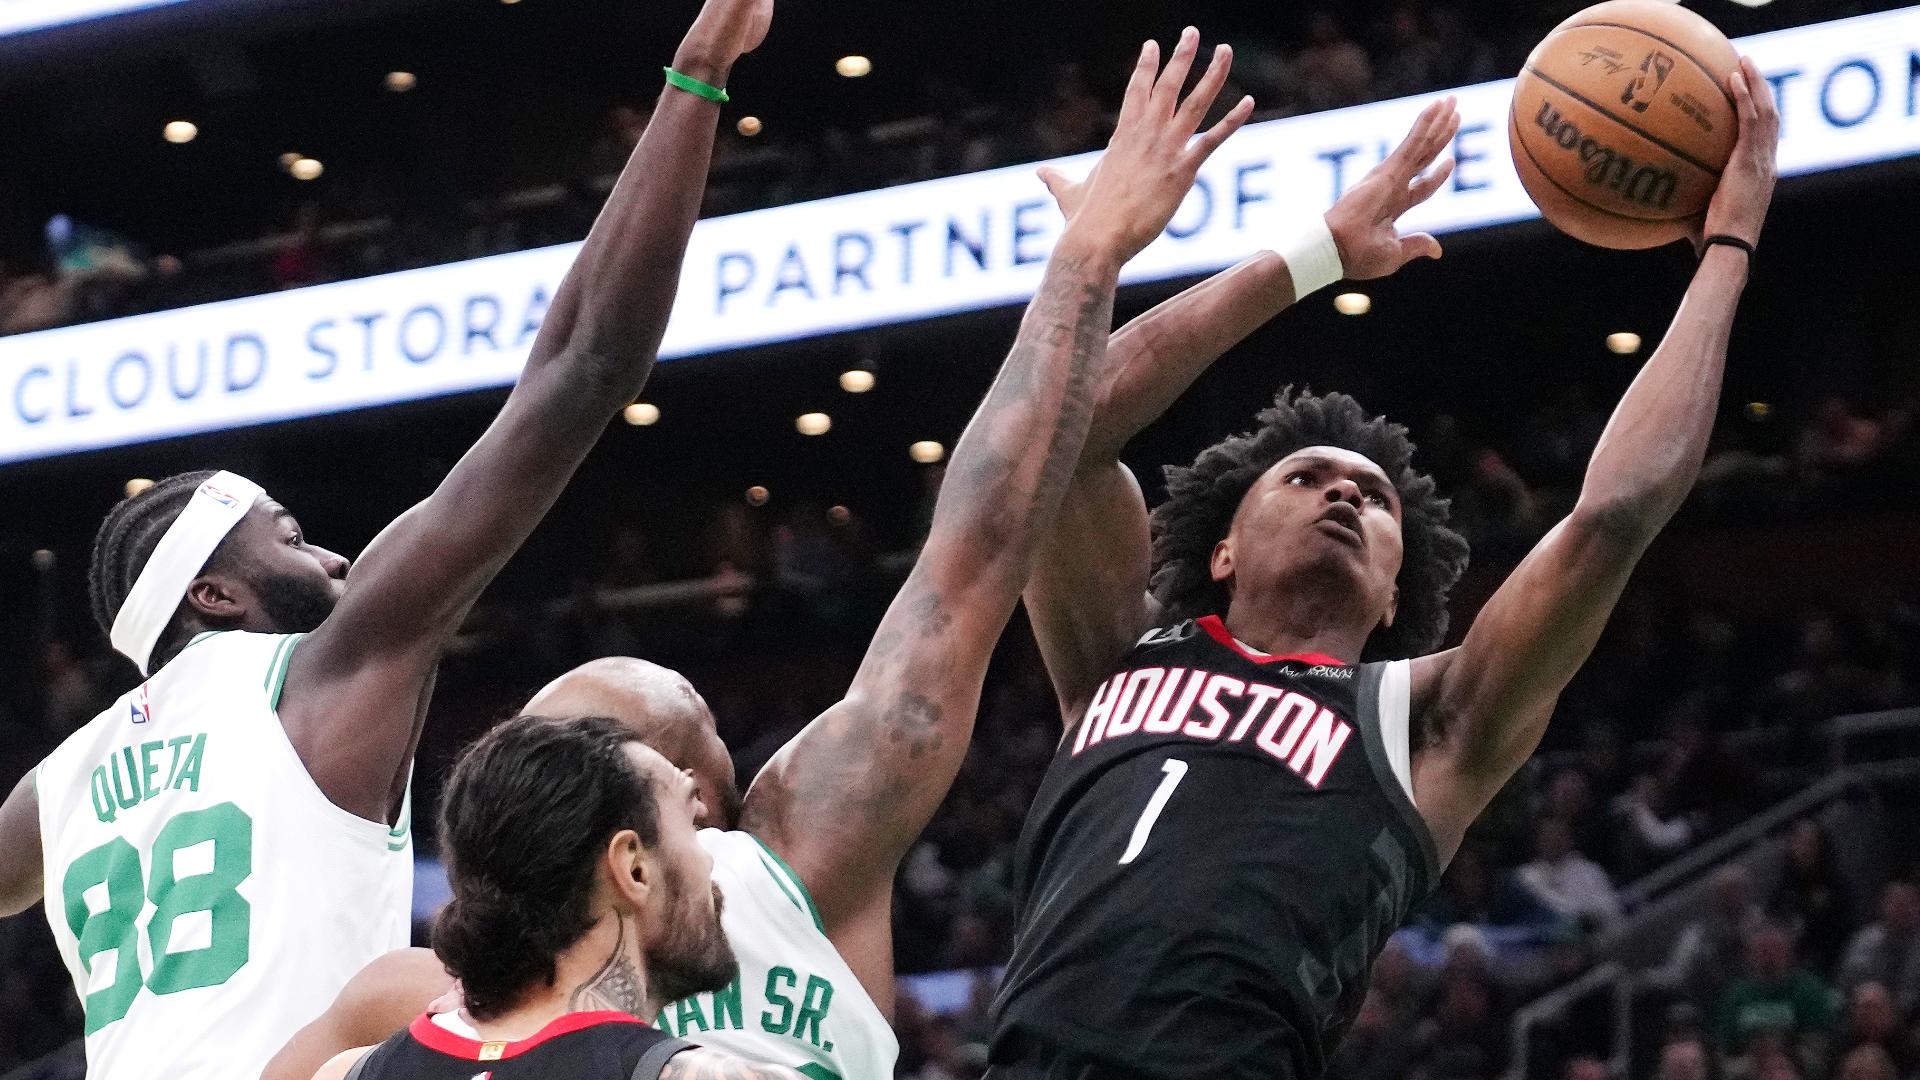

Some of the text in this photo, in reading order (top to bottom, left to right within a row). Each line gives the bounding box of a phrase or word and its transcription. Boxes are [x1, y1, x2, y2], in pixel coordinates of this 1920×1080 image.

[1535, 99, 1679, 210] Wilson
[13, 332, 269, 425] CLOUD
[1165, 159, 1270, 241] OF
[1316, 121, 1491, 204] TE
[91, 732, 208, 825] QUETA
[1071, 666, 1357, 790] HOUSTON
[1118, 757, 1190, 866] 1
[62, 800, 253, 1037] 88
[656, 964, 835, 1053] AN SR.
